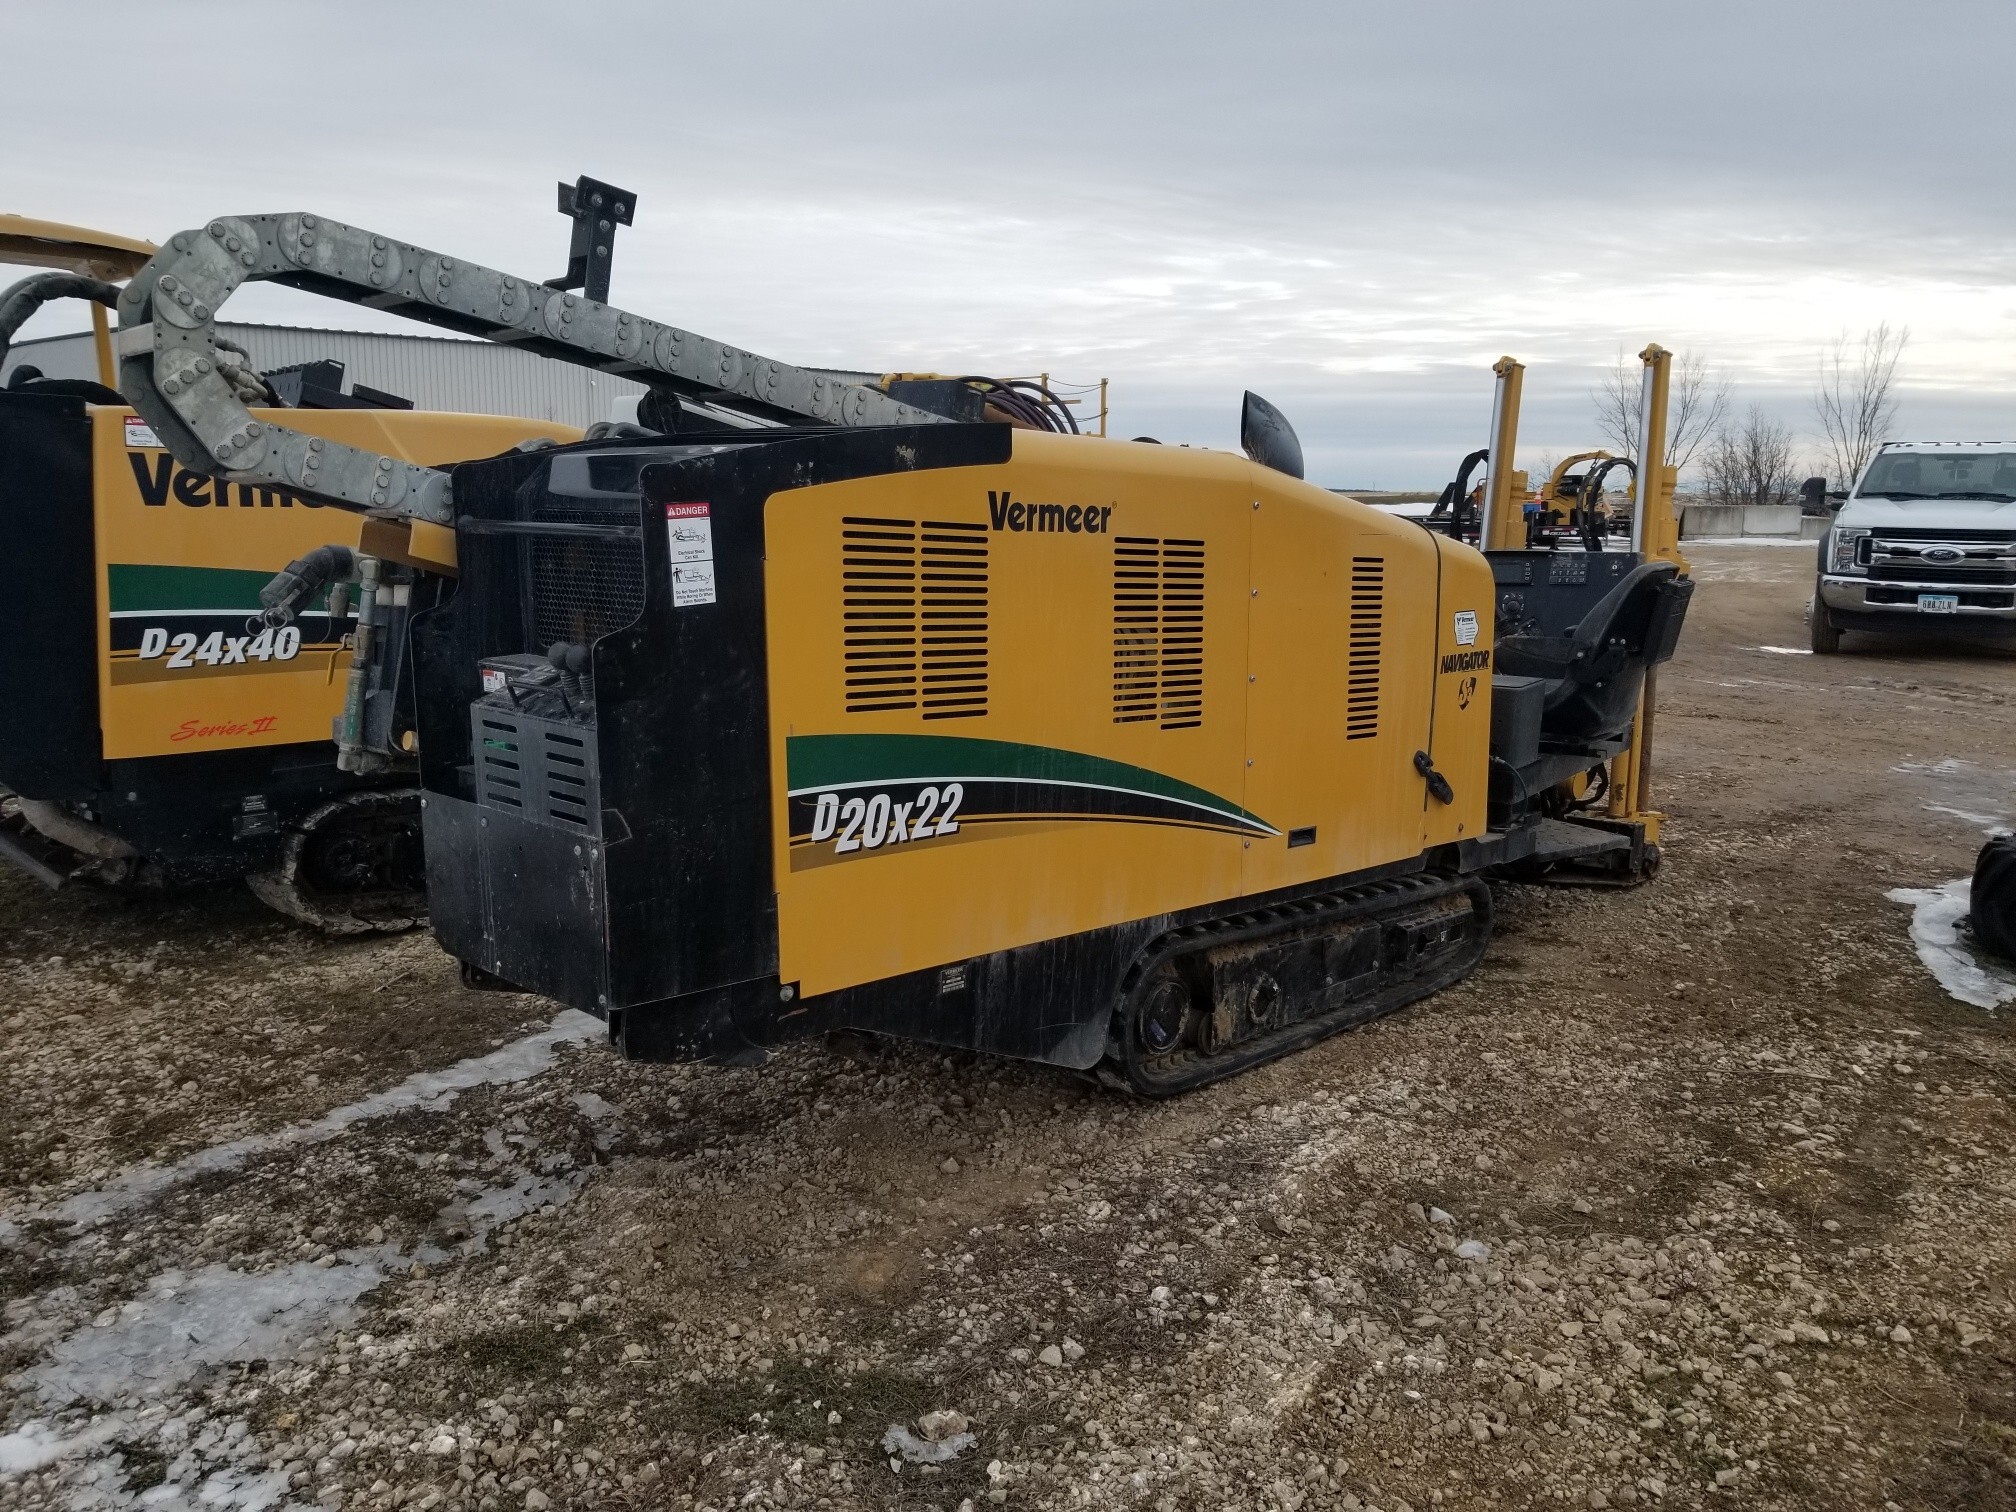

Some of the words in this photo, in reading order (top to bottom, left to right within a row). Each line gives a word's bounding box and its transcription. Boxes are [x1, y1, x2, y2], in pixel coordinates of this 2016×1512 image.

[675, 506, 708, 516] DANGER
[987, 490, 1112, 534] Vermeer
[139, 626, 301, 669] D24x40
[1440, 650, 1490, 675] NAVIGATOR
[170, 720, 249, 742] Series
[248, 716, 279, 736] II
[811, 782, 964, 855] D20x22
